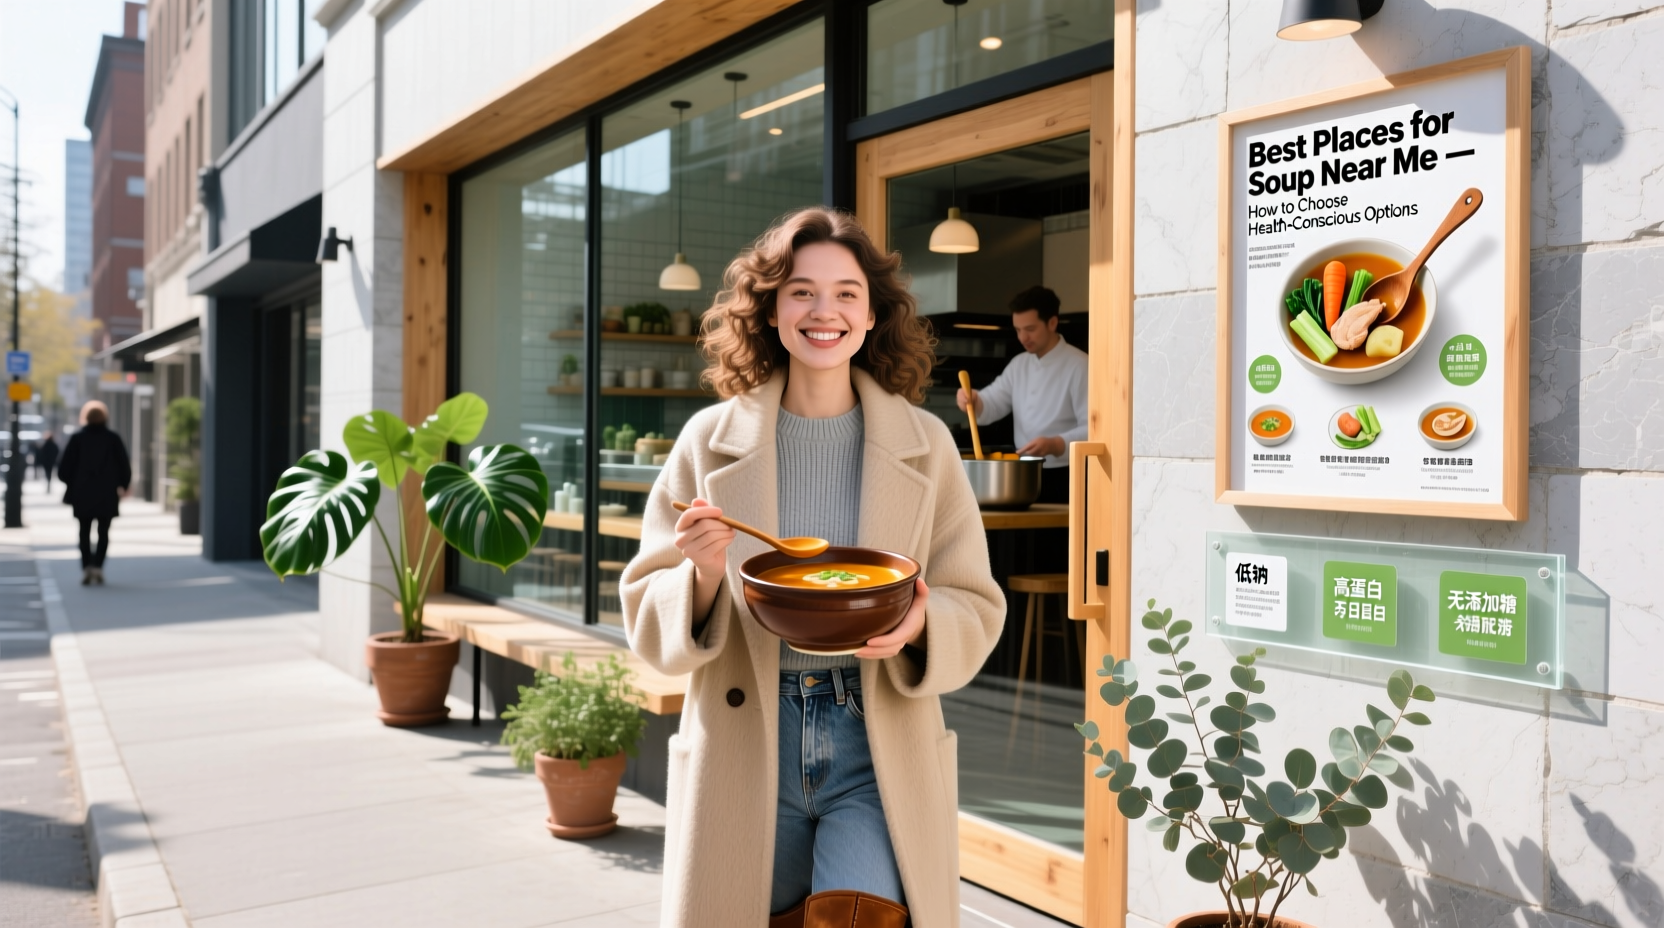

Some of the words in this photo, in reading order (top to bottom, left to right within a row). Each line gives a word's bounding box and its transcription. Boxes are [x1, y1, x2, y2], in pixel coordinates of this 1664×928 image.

[1248, 135, 1307, 168] Best
[1313, 121, 1404, 156] Places
[1410, 109, 1455, 139] for
[1248, 169, 1315, 196] Soup
[1321, 156, 1387, 187] Near
[1393, 145, 1438, 176] Me
[1248, 205, 1279, 219] How
[1281, 202, 1295, 215] to
[1297, 194, 1349, 213] Choose
[1364, 203, 1419, 224] Options
[1333, 576, 1382, 601] 高蛋白
